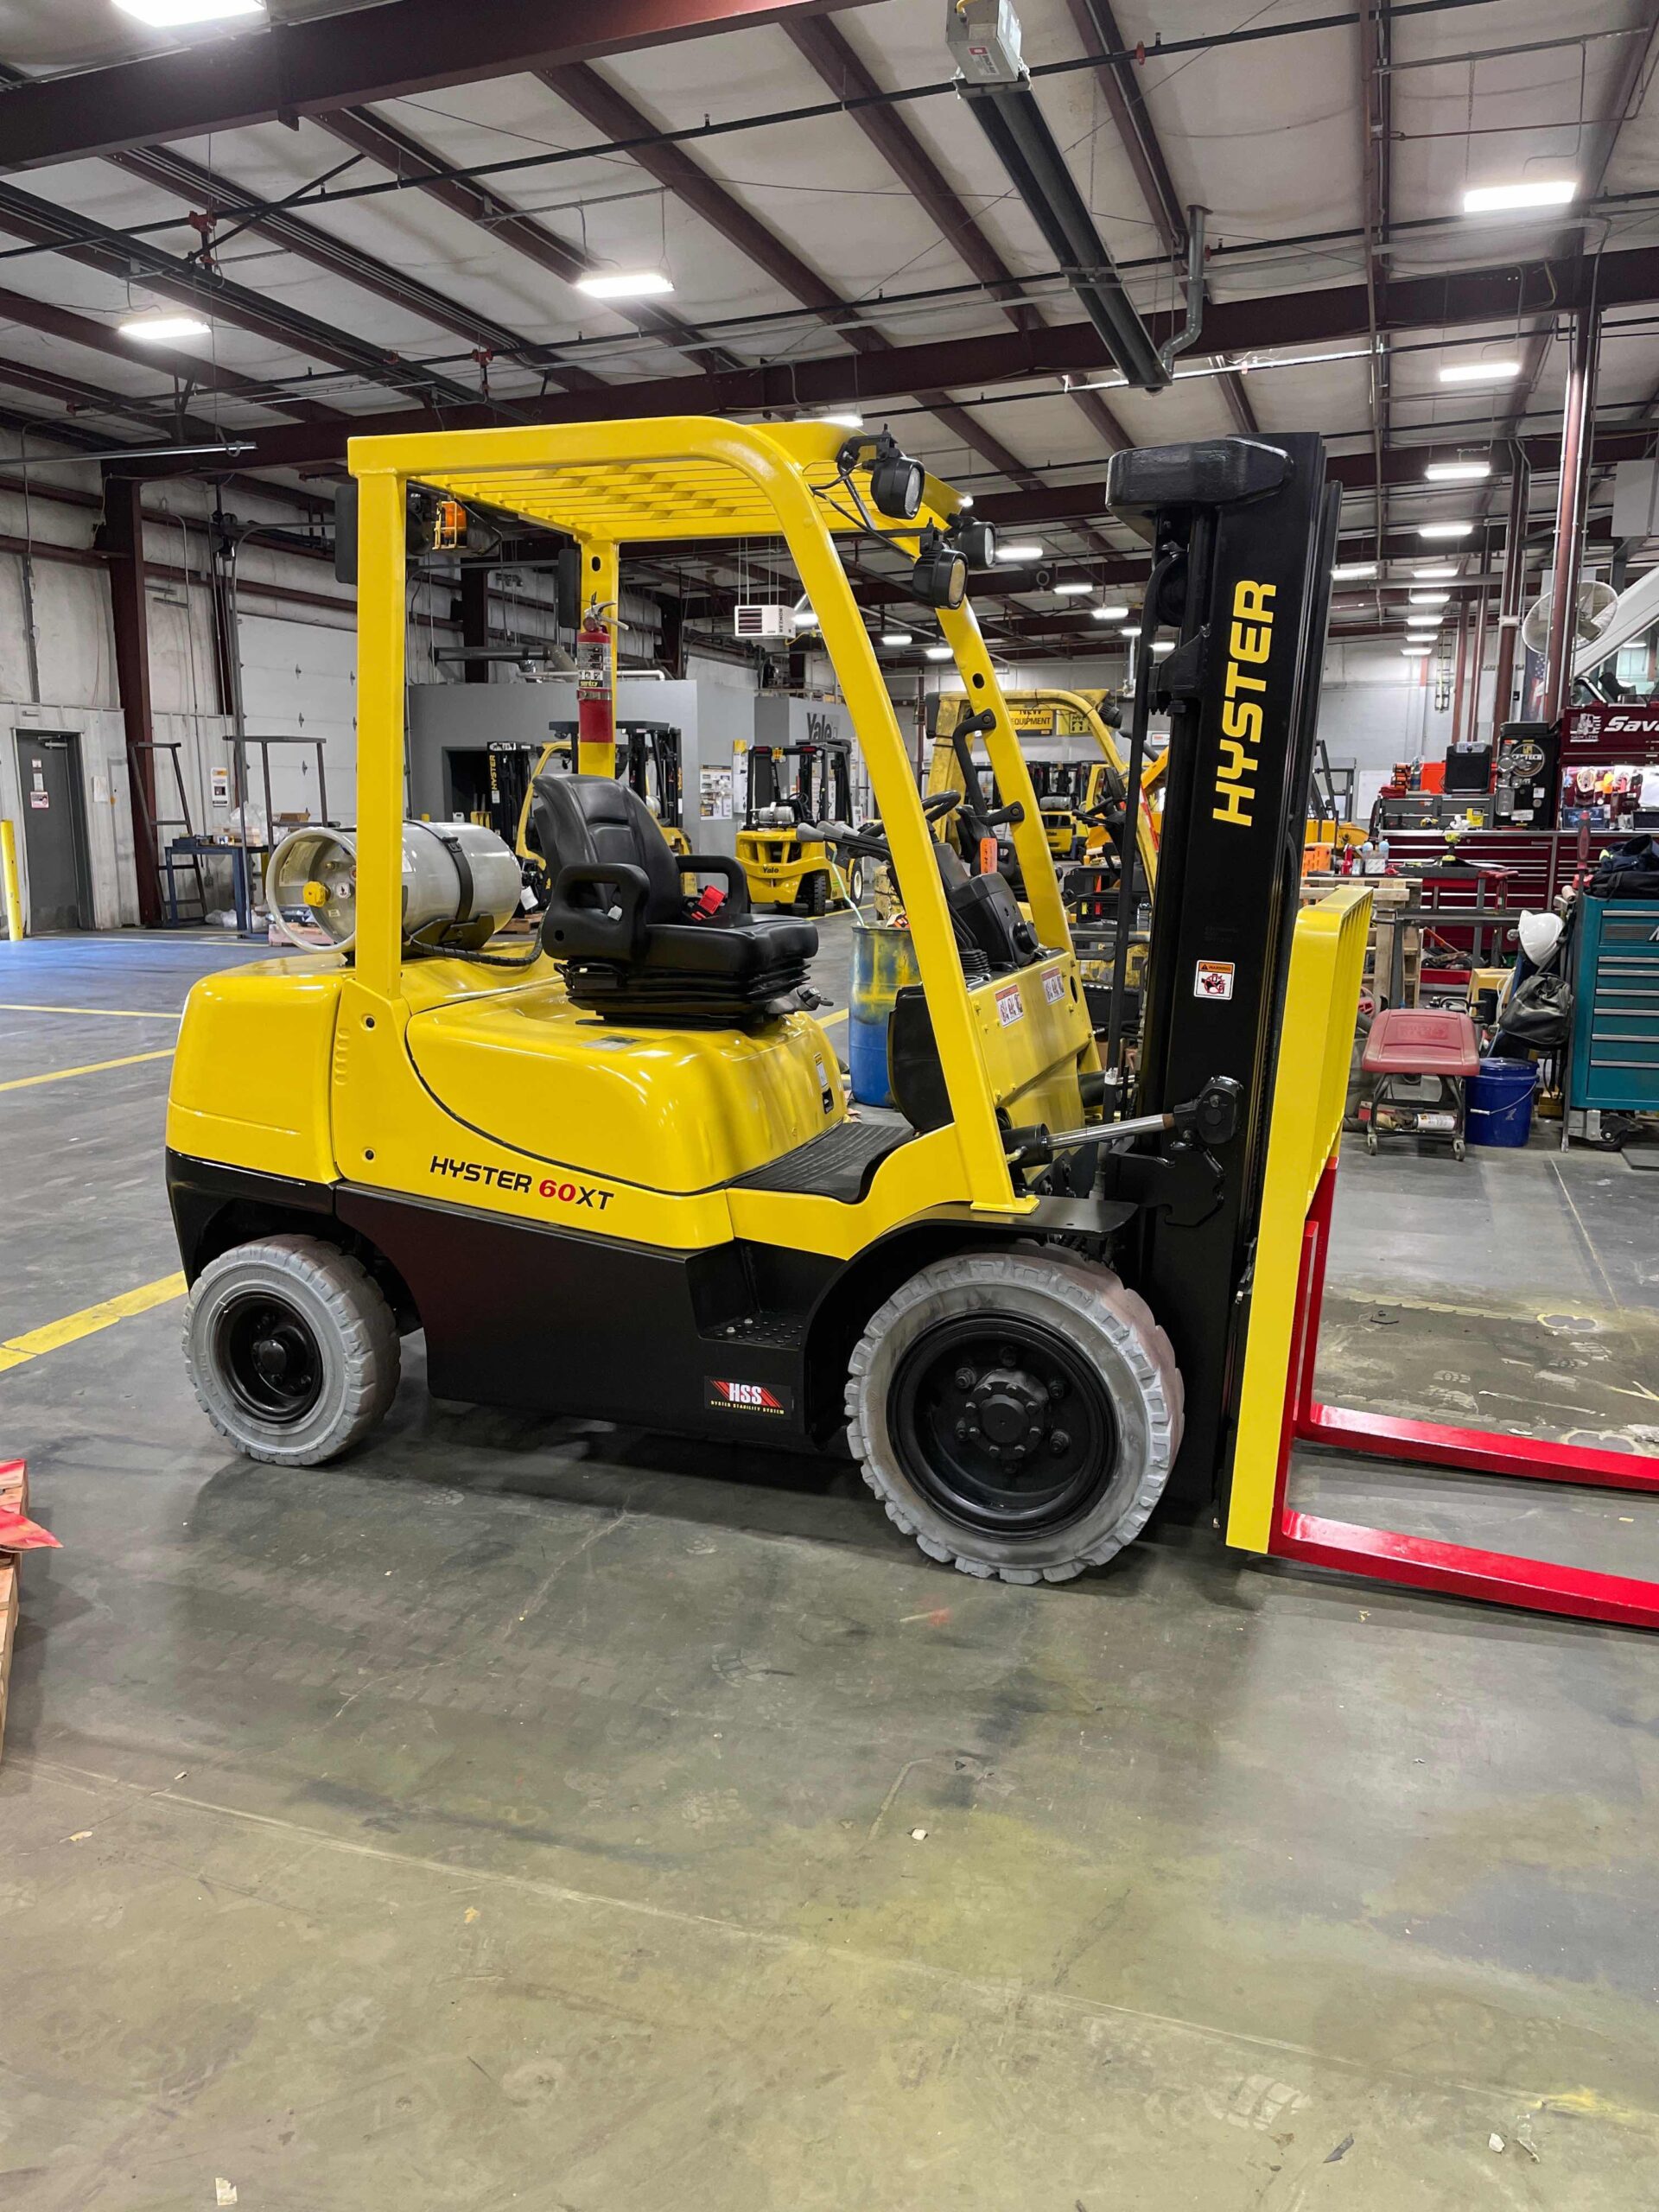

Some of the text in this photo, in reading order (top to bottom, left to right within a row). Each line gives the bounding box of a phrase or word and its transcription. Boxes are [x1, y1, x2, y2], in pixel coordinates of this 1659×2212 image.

[1212, 580, 1277, 827] HYSTER
[489, 754, 498, 791] HYSTER
[429, 1155, 614, 1211] HYSTER 60XT
[728, 1382, 762, 1405] HSS
